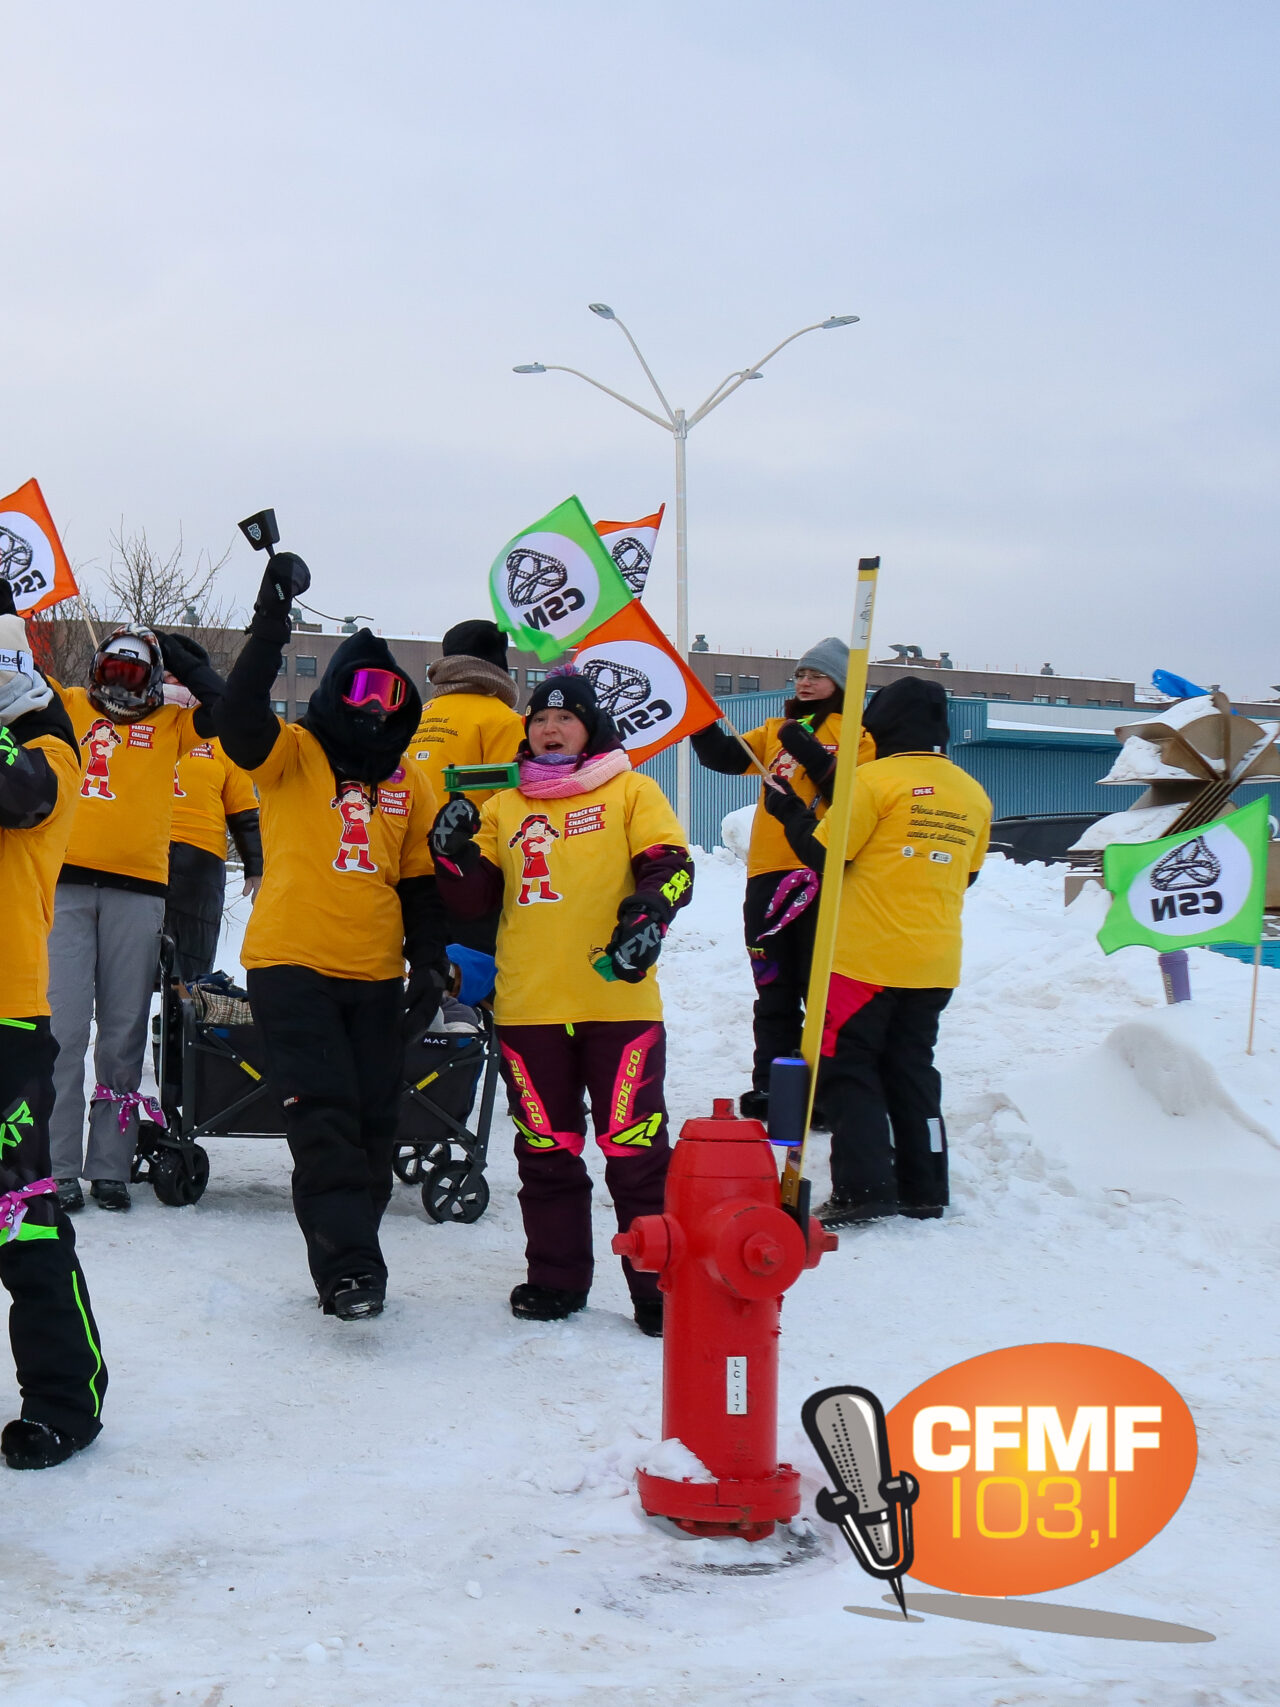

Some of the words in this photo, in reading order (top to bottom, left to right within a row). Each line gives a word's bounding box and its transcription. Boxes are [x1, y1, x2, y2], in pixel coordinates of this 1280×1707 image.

[569, 809, 588, 819] PARCE
[588, 806, 601, 814] QUE
[568, 815, 597, 827] CHACUNE
[423, 1037, 449, 1045] MAC
[509, 1058, 532, 1100] RIDE
[614, 1079, 633, 1124] RIDE
[625, 1048, 643, 1078] CO.
